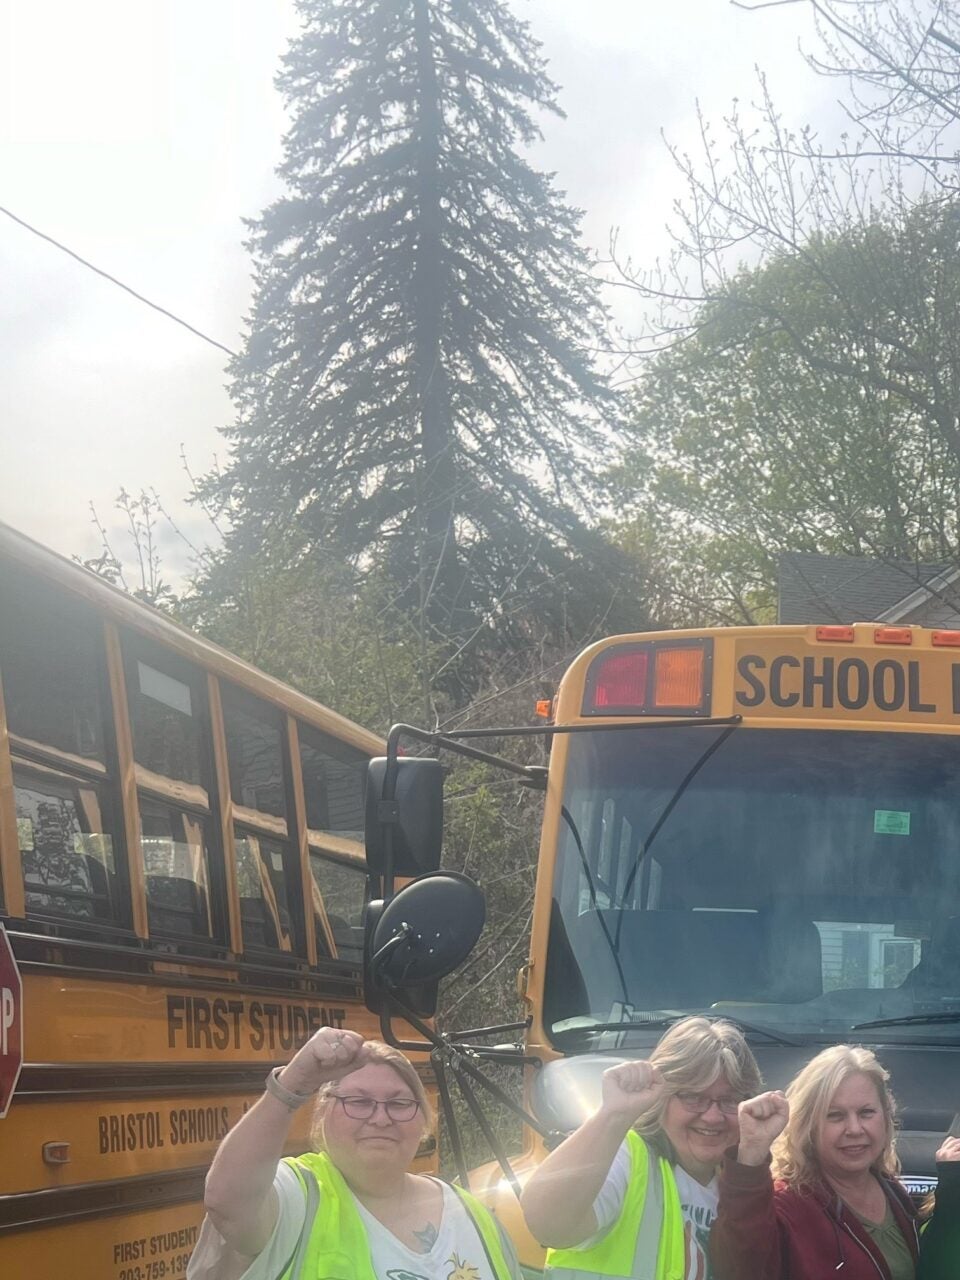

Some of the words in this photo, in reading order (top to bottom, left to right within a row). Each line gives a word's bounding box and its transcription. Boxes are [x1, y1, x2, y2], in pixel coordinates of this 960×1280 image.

[735, 655, 936, 713] SCHOOL
[166, 995, 244, 1050] FIRST
[98, 1111, 164, 1154] BRISTOL
[169, 1106, 229, 1146] SCHOOLS
[113, 1239, 147, 1265] FIRST
[150, 1226, 198, 1255] STUDENT
